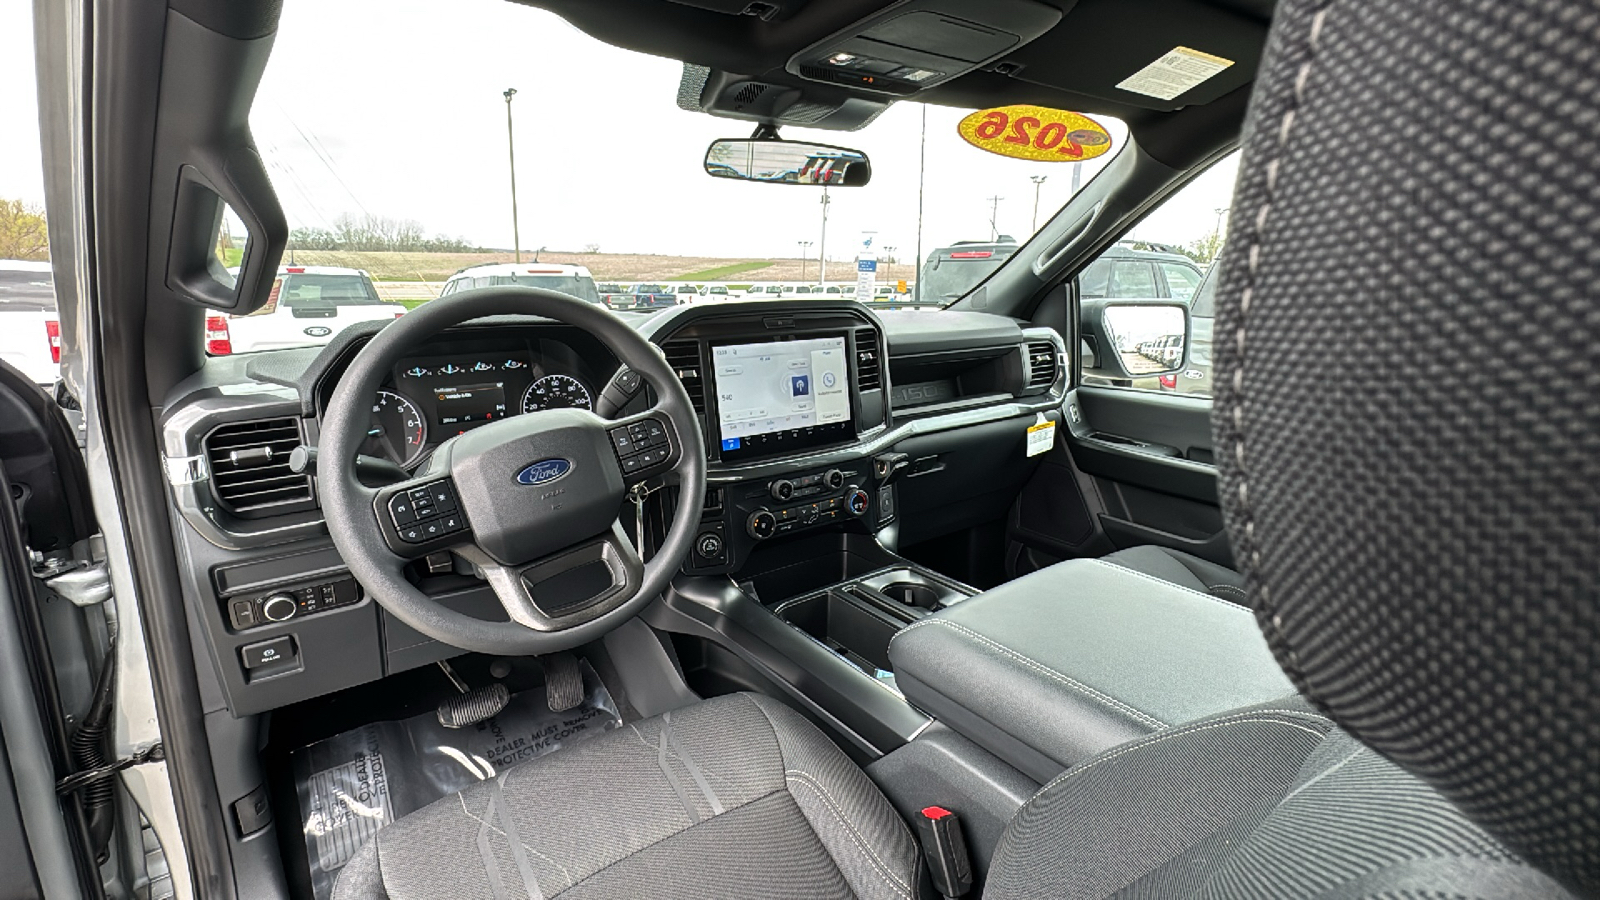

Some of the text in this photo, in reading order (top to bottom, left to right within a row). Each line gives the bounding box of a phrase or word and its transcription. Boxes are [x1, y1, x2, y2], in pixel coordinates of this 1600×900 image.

[551, 379, 559, 387] 60
[380, 398, 387, 406] 4
[397, 405, 404, 413] 5
[529, 403, 538, 411] 20
[407, 419, 414, 427] 6
[406, 436, 413, 444] 7
[529, 463, 560, 482] Ford
[486, 709, 603, 759] DEALER MUST REMOVE
[492, 722, 587, 768] PROTECTIVE COVER
